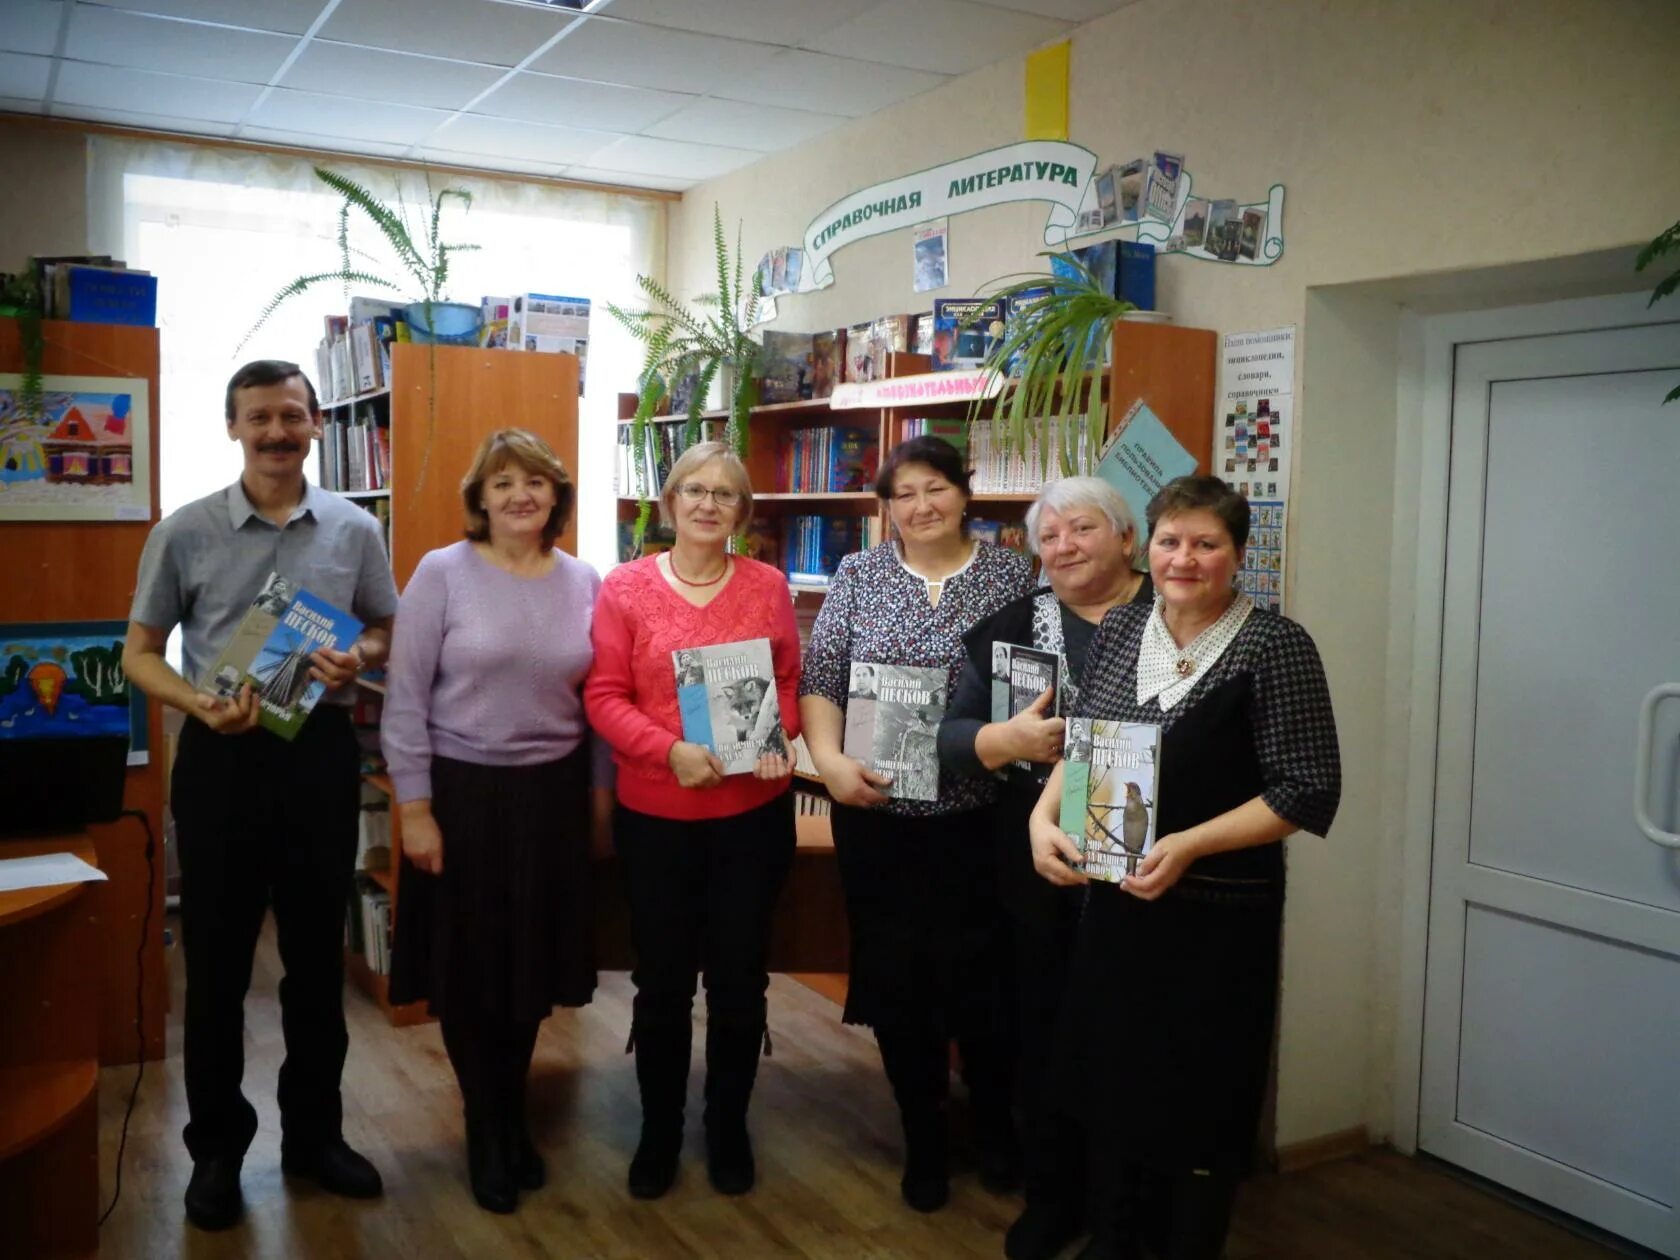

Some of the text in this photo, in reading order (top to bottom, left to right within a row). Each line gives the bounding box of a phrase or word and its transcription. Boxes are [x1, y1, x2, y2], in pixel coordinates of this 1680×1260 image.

[812, 161, 1078, 250] СПРАВОЧНАЯ ЛИТЕРАТУРА
[1134, 443, 1163, 477] ПРАВИЛА
[292, 601, 335, 630] Василий
[284, 611, 338, 649] ПЕСКОВ
[706, 656, 747, 667] Василий
[1011, 658, 1040, 675] Василий
[708, 664, 759, 682] ПЕСКОВ
[1011, 671, 1046, 692] ПЕСКОВ
[881, 676, 922, 689] Василий
[880, 687, 931, 705] ПЕСКОВ
[1093, 734, 1132, 749] Василий
[1092, 748, 1140, 769] ПЕСКОВ
[1086, 839, 1102, 851] МИР
